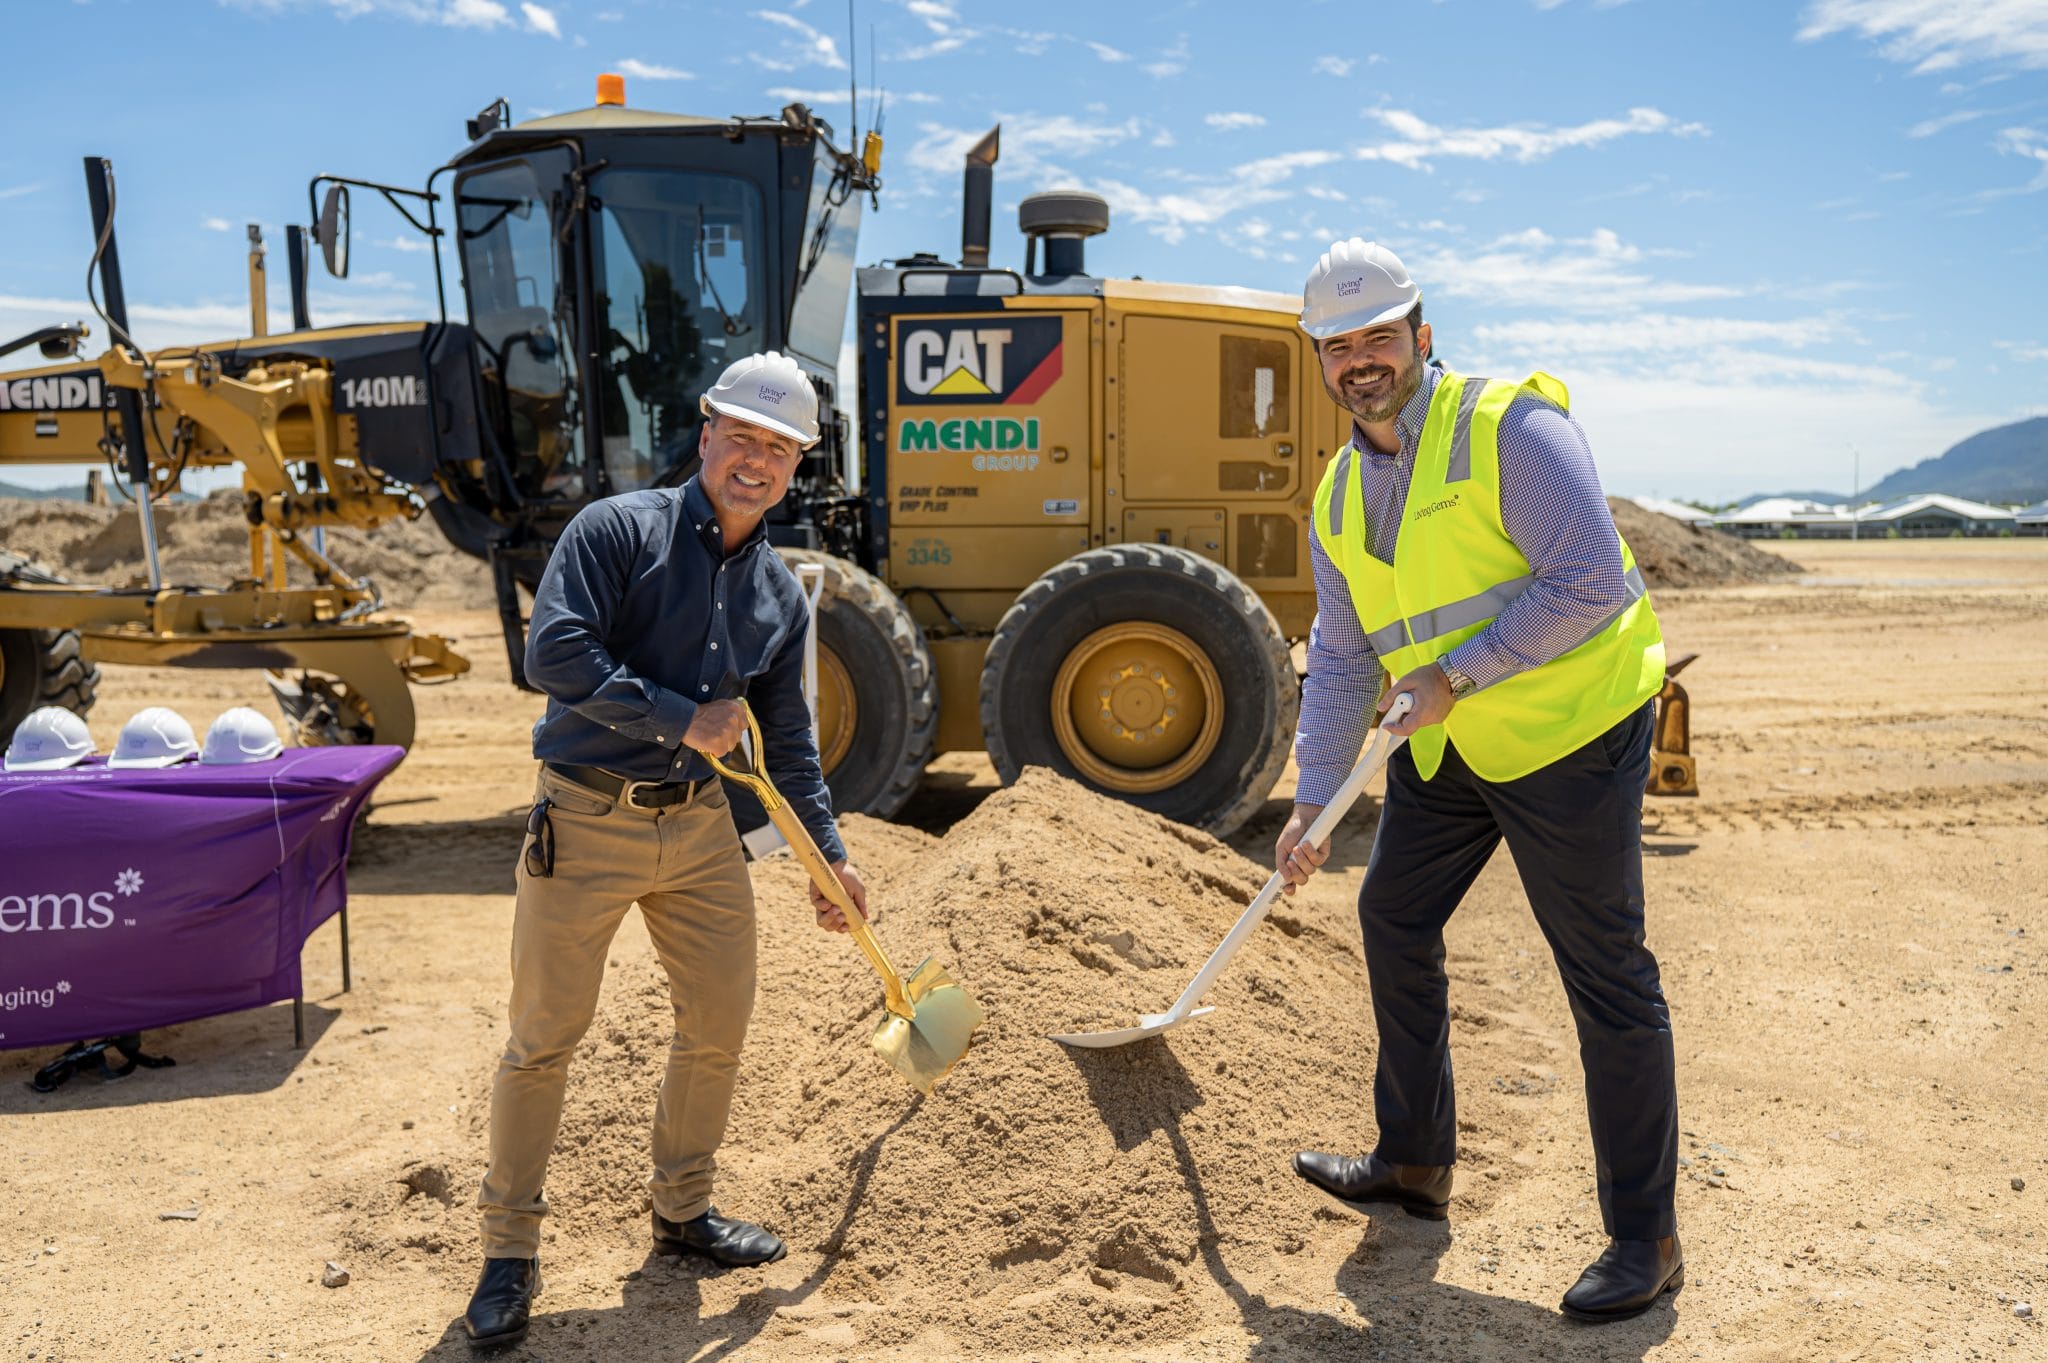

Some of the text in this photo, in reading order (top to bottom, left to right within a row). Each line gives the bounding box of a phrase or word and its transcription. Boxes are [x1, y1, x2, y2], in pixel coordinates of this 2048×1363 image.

[1336, 279, 1361, 290] Living
[1338, 288, 1361, 297] Gems
[904, 329, 1012, 395] CAT
[758, 392, 781, 404] Gems
[759, 385, 783, 400] Living
[899, 417, 1040, 452] MENDI
[972, 455, 1040, 471] GROUP
[906, 547, 953, 566] 3345
